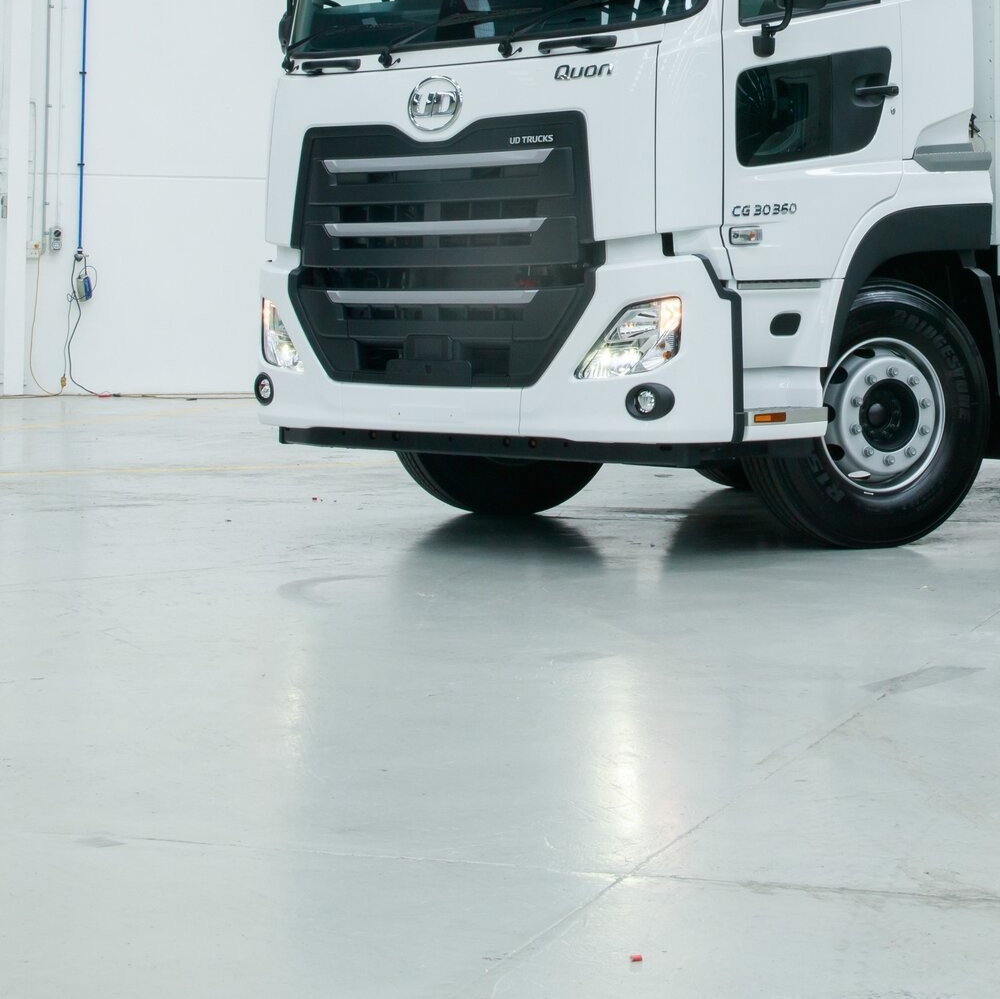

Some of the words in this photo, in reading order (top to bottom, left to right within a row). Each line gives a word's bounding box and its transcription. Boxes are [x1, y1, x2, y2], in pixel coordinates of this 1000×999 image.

[554, 63, 614, 80] Quon
[411, 90, 457, 118] UD
[509, 137, 521, 145] UD
[522, 134, 554, 144] TRUCKS
[732, 205, 751, 217] CG
